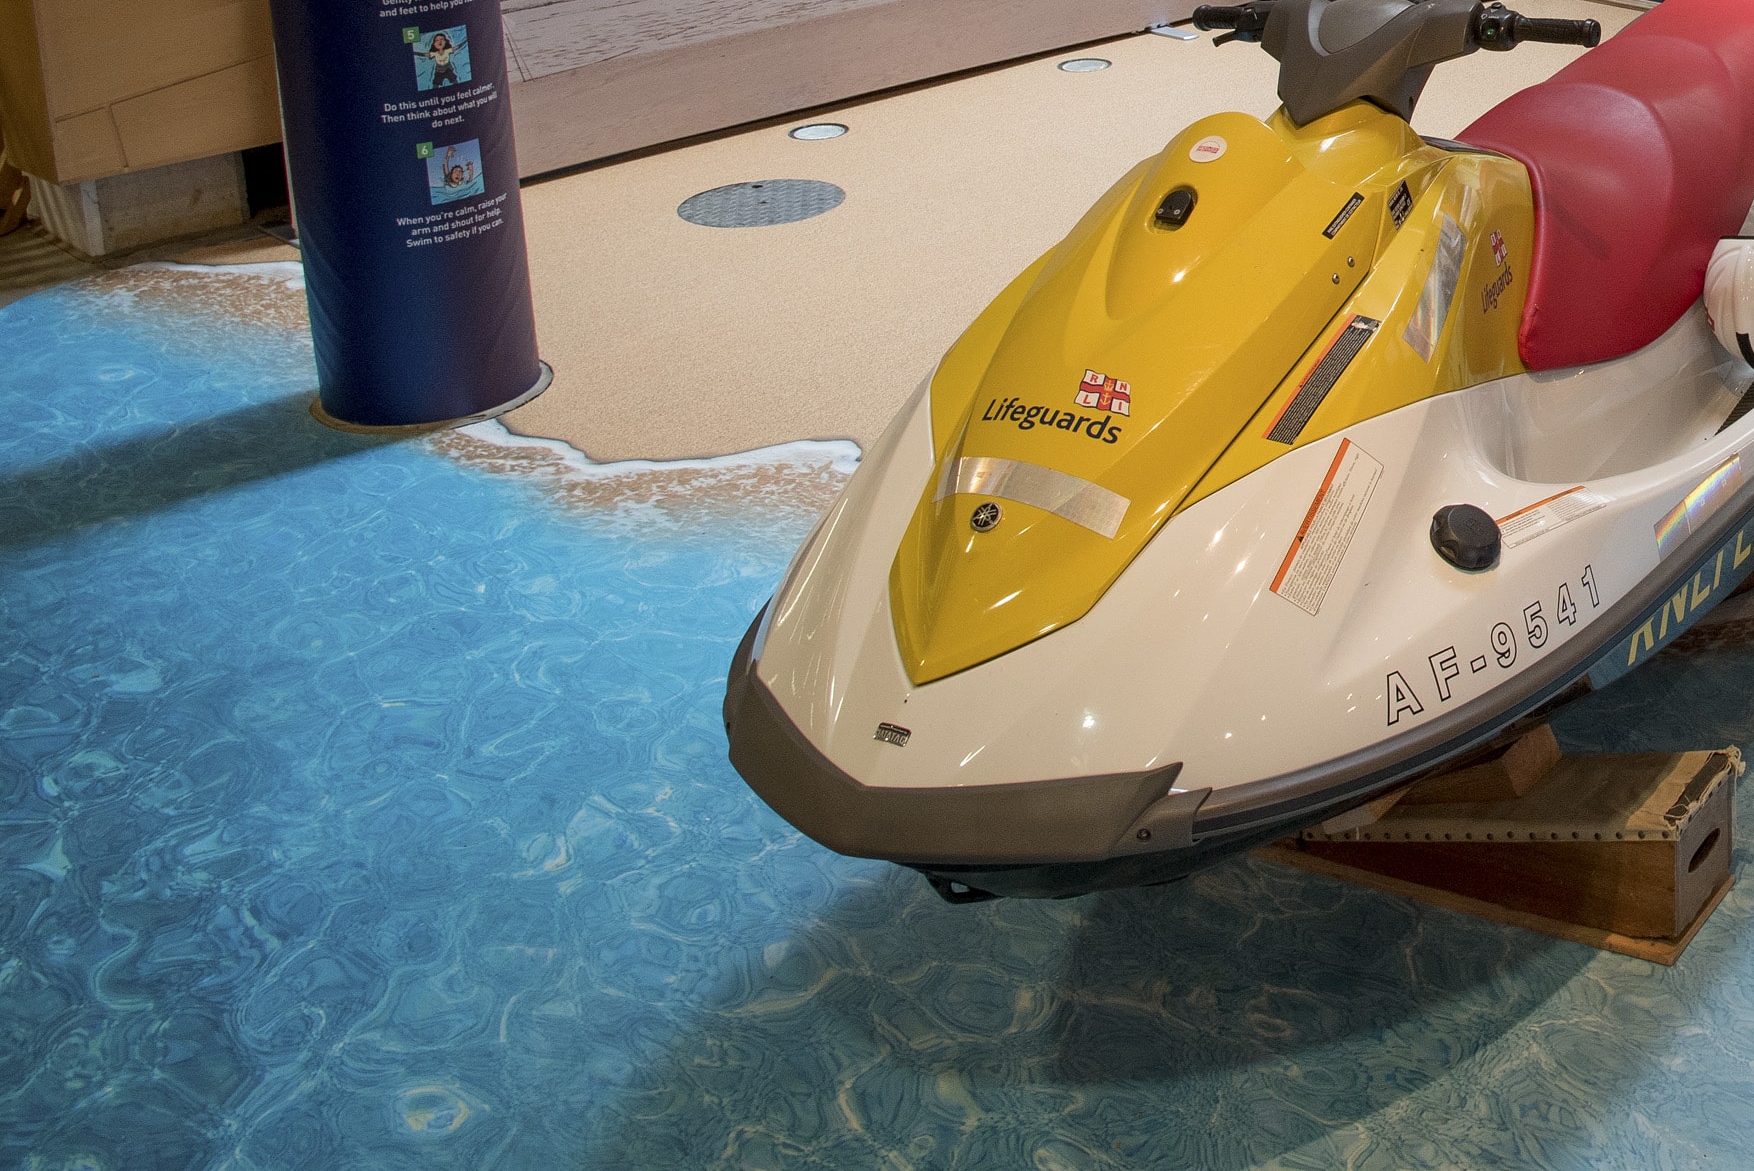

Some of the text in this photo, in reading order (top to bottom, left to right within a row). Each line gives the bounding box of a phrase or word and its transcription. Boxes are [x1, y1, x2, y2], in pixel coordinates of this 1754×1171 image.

[407, 30, 414, 39] 5
[421, 145, 428, 154] 6
[1481, 261, 1512, 314] Lifeguards
[982, 397, 1122, 444] Lifeguards
[1387, 564, 1599, 726] AF-9541
